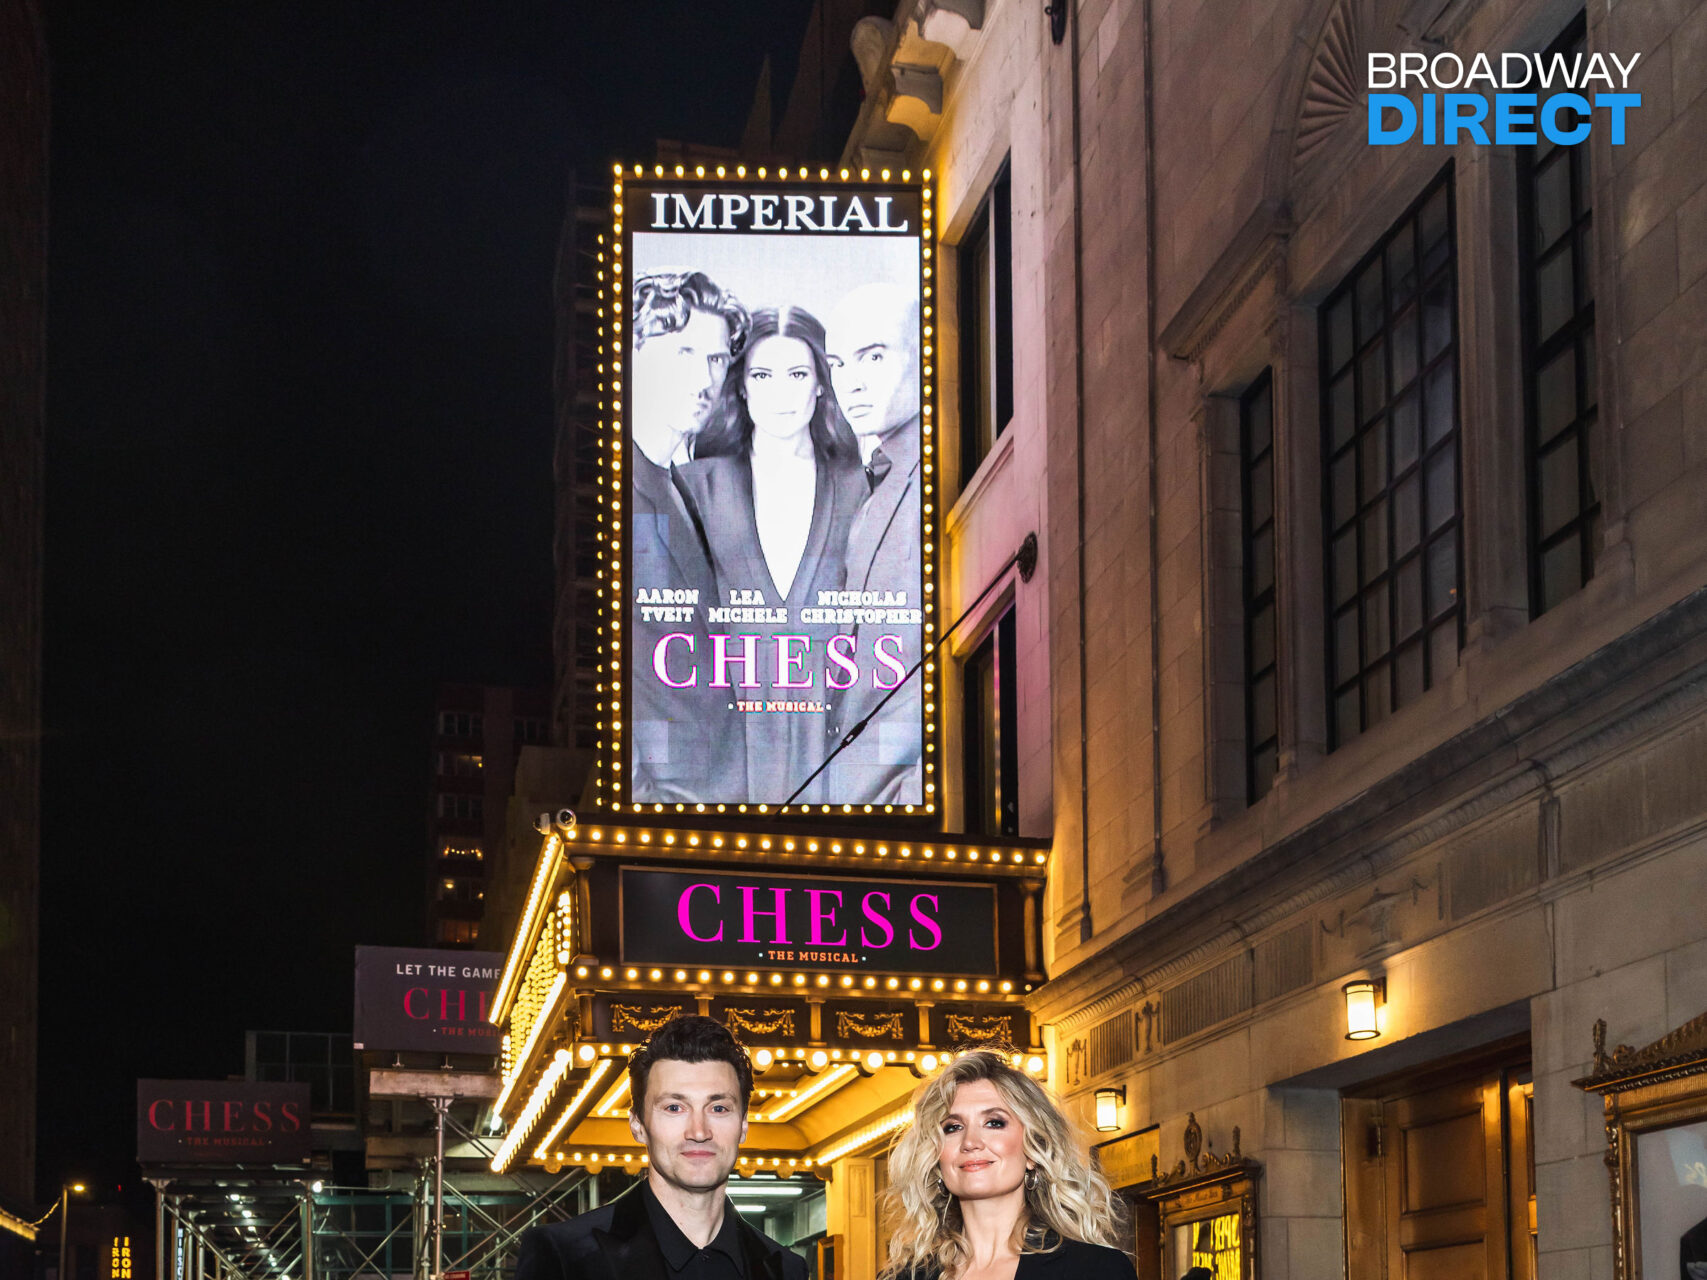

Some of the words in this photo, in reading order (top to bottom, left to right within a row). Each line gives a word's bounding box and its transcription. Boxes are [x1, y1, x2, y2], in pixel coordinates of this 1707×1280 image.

[651, 192, 908, 232] IMPERIAL
[636, 588, 699, 605] AARON
[729, 589, 765, 605] LEA
[817, 591, 907, 607] NICHOLAS
[641, 606, 694, 623] TVEIT
[708, 607, 788, 624] MICHELE
[800, 608, 922, 625] CHRISTOPHER
[652, 632, 907, 690] CHESS
[737, 700, 763, 712] THE
[766, 701, 824, 713] MUSICAL
[677, 883, 942, 951] CHESS
[768, 950, 795, 961] THE
[799, 951, 859, 964] MUSICAL
[396, 964, 422, 976] LET
[428, 965, 456, 977] THE
[462, 967, 501, 979] GAME
[441, 1027, 464, 1036] THE
[148, 1099, 300, 1132] CHESS
[187, 1137, 209, 1146] THE
[214, 1137, 265, 1146] MUSICAL
[120, 1236, 132, 1279] IRON
